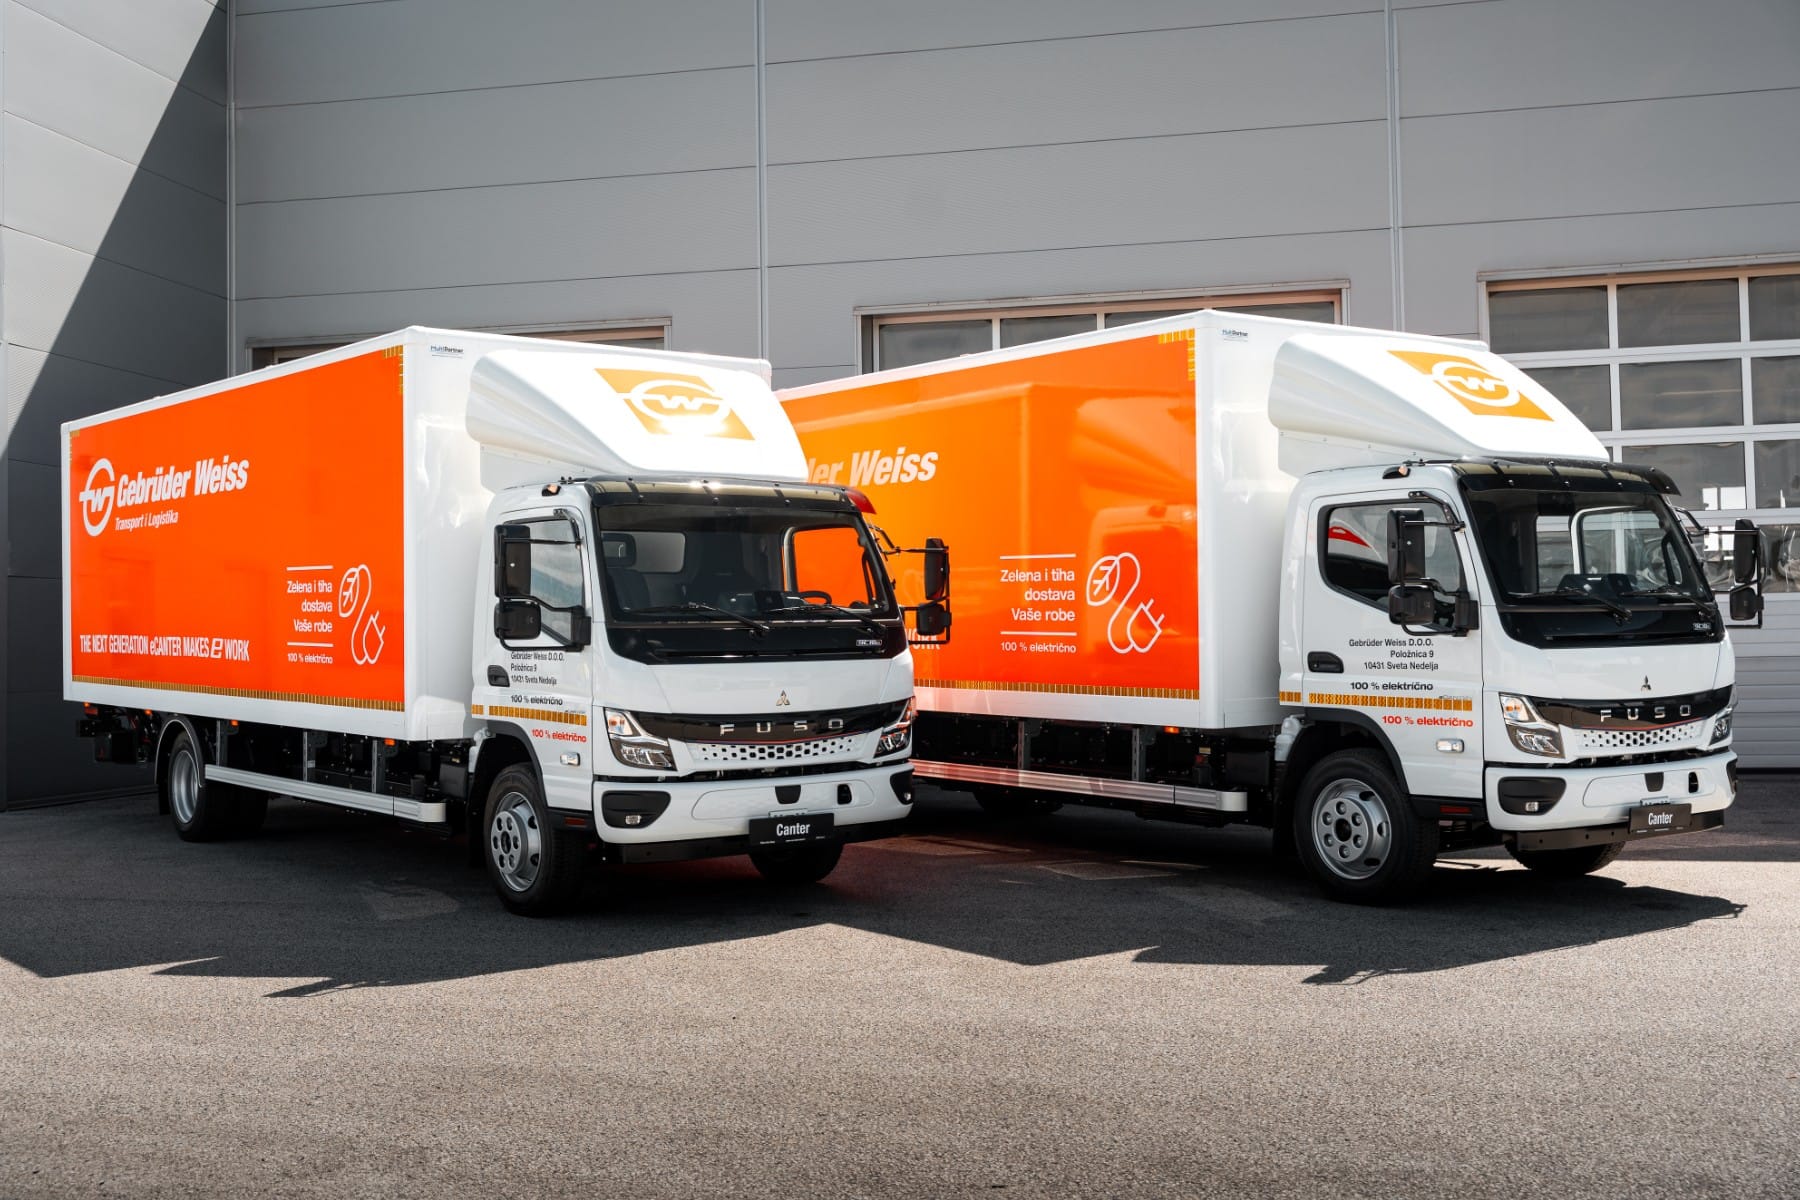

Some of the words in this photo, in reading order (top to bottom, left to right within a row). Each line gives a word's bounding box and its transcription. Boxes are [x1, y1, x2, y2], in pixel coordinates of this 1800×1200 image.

[849, 446, 939, 487] Weiss
[117, 466, 192, 508] Gebrüder
[194, 454, 250, 496] Weiss
[115, 514, 144, 532] Transport
[148, 510, 178, 528] Logistika
[1000, 568, 1042, 582] Zelena
[1044, 568, 1048, 582] i
[1051, 568, 1075, 582] tiha
[287, 580, 312, 594] Zelena
[318, 579, 332, 592] tiha
[1024, 587, 1076, 601] dostava
[301, 599, 332, 612] dostava
[1011, 607, 1042, 621] Vaše
[1045, 608, 1076, 622] robe
[294, 618, 312, 632] Vaše
[314, 620, 333, 632] robe
[80, 634, 92, 653] THE
[92, 634, 108, 653] NEXT
[109, 634, 148, 654] GENERATION
[150, 636, 182, 656] eCANTER
[183, 636, 209, 658] MAKES
[224, 639, 250, 662] WORK
[1001, 642, 1017, 652] 100
[1020, 642, 1028, 652] %
[1030, 642, 1077, 654] električno
[1349, 638, 1383, 647] Gebrüder
[1384, 638, 1407, 646] Weiss
[1408, 638, 1434, 646] D.O.O.
[288, 652, 298, 662] 100
[1390, 650, 1427, 658] Položnica
[1410, 662, 1438, 672] Nedelja
[1350, 682, 1368, 690] 100
[1371, 682, 1380, 690] %
[1382, 682, 1434, 690] električno
[511, 695, 522, 703] 100
[530, 696, 563, 706] električno
[1600, 704, 1691, 722] FUSO
[720, 718, 844, 736] FUSO
[1382, 716, 1402, 724] 100
[1404, 716, 1414, 725] %
[1416, 716, 1474, 728] električno
[532, 728, 544, 738] 100
[552, 730, 587, 742] električno
[1648, 812, 1673, 826] Canter
[776, 822, 811, 836] Canter
